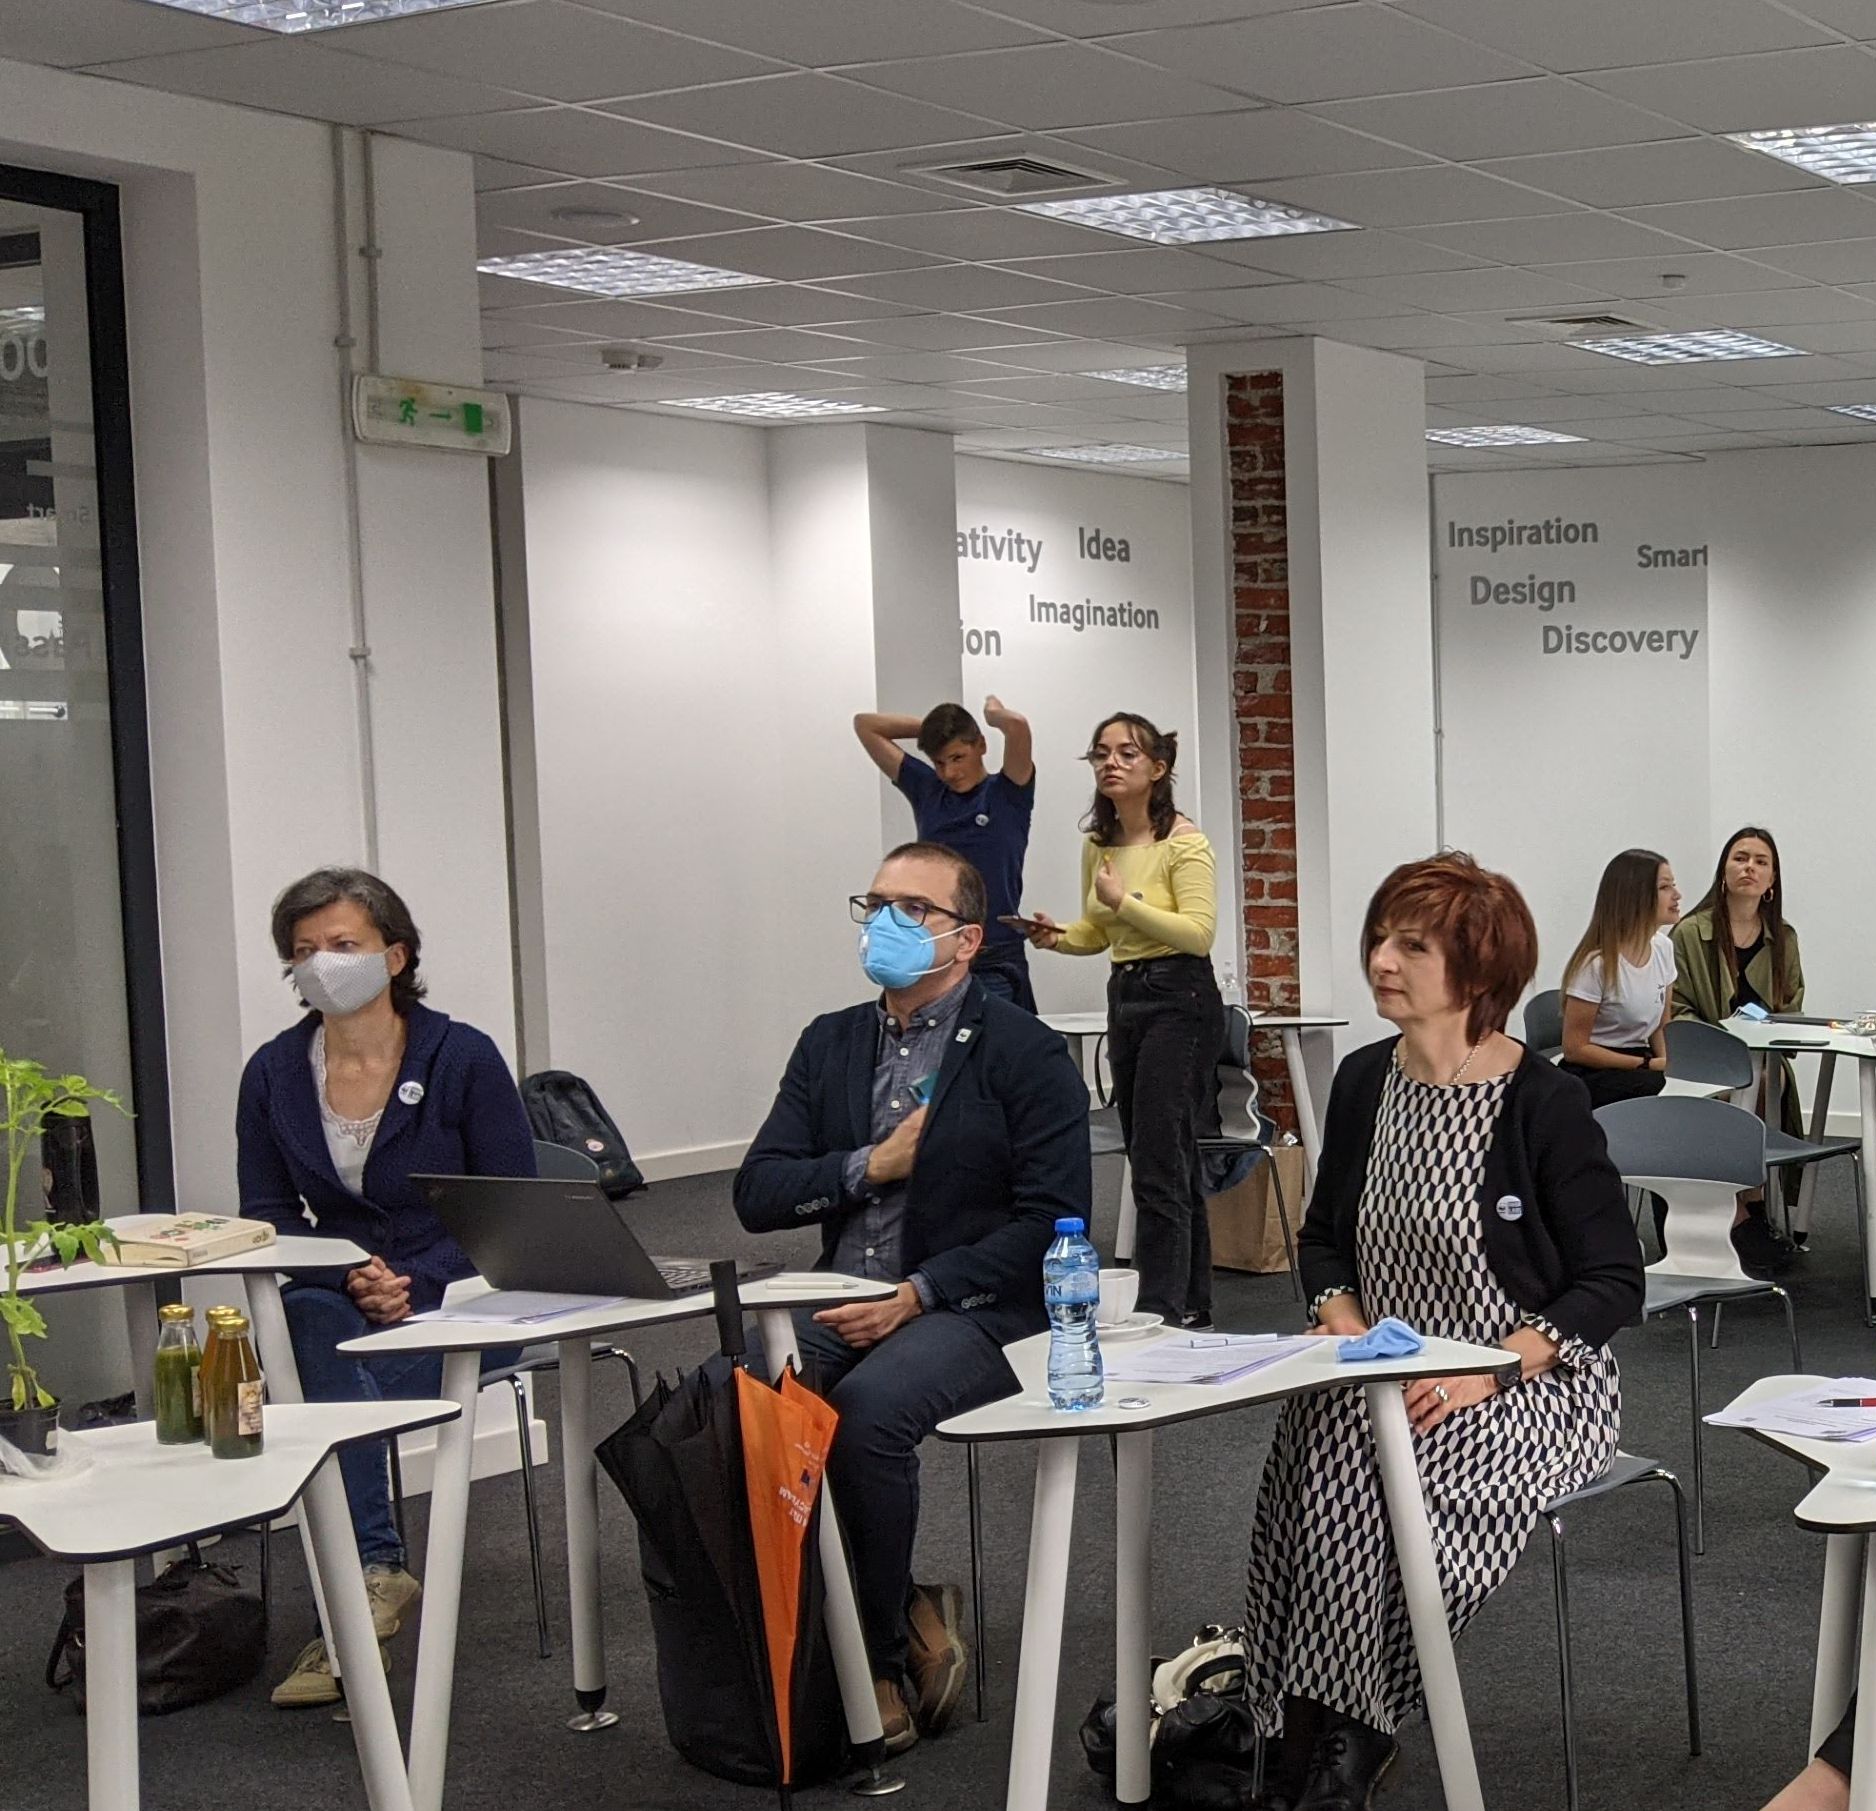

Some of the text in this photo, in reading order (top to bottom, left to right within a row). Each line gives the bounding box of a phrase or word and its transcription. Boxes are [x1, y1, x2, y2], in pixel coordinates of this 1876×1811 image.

[957, 525, 1043, 573] ativity
[1078, 526, 1131, 563] Idea
[1448, 517, 1599, 552] Inspiration
[1637, 544, 1708, 568] Smart
[1470, 574, 1575, 612] Design
[1029, 594, 1159, 632] Imagination
[1542, 624, 1699, 660] Discovery
